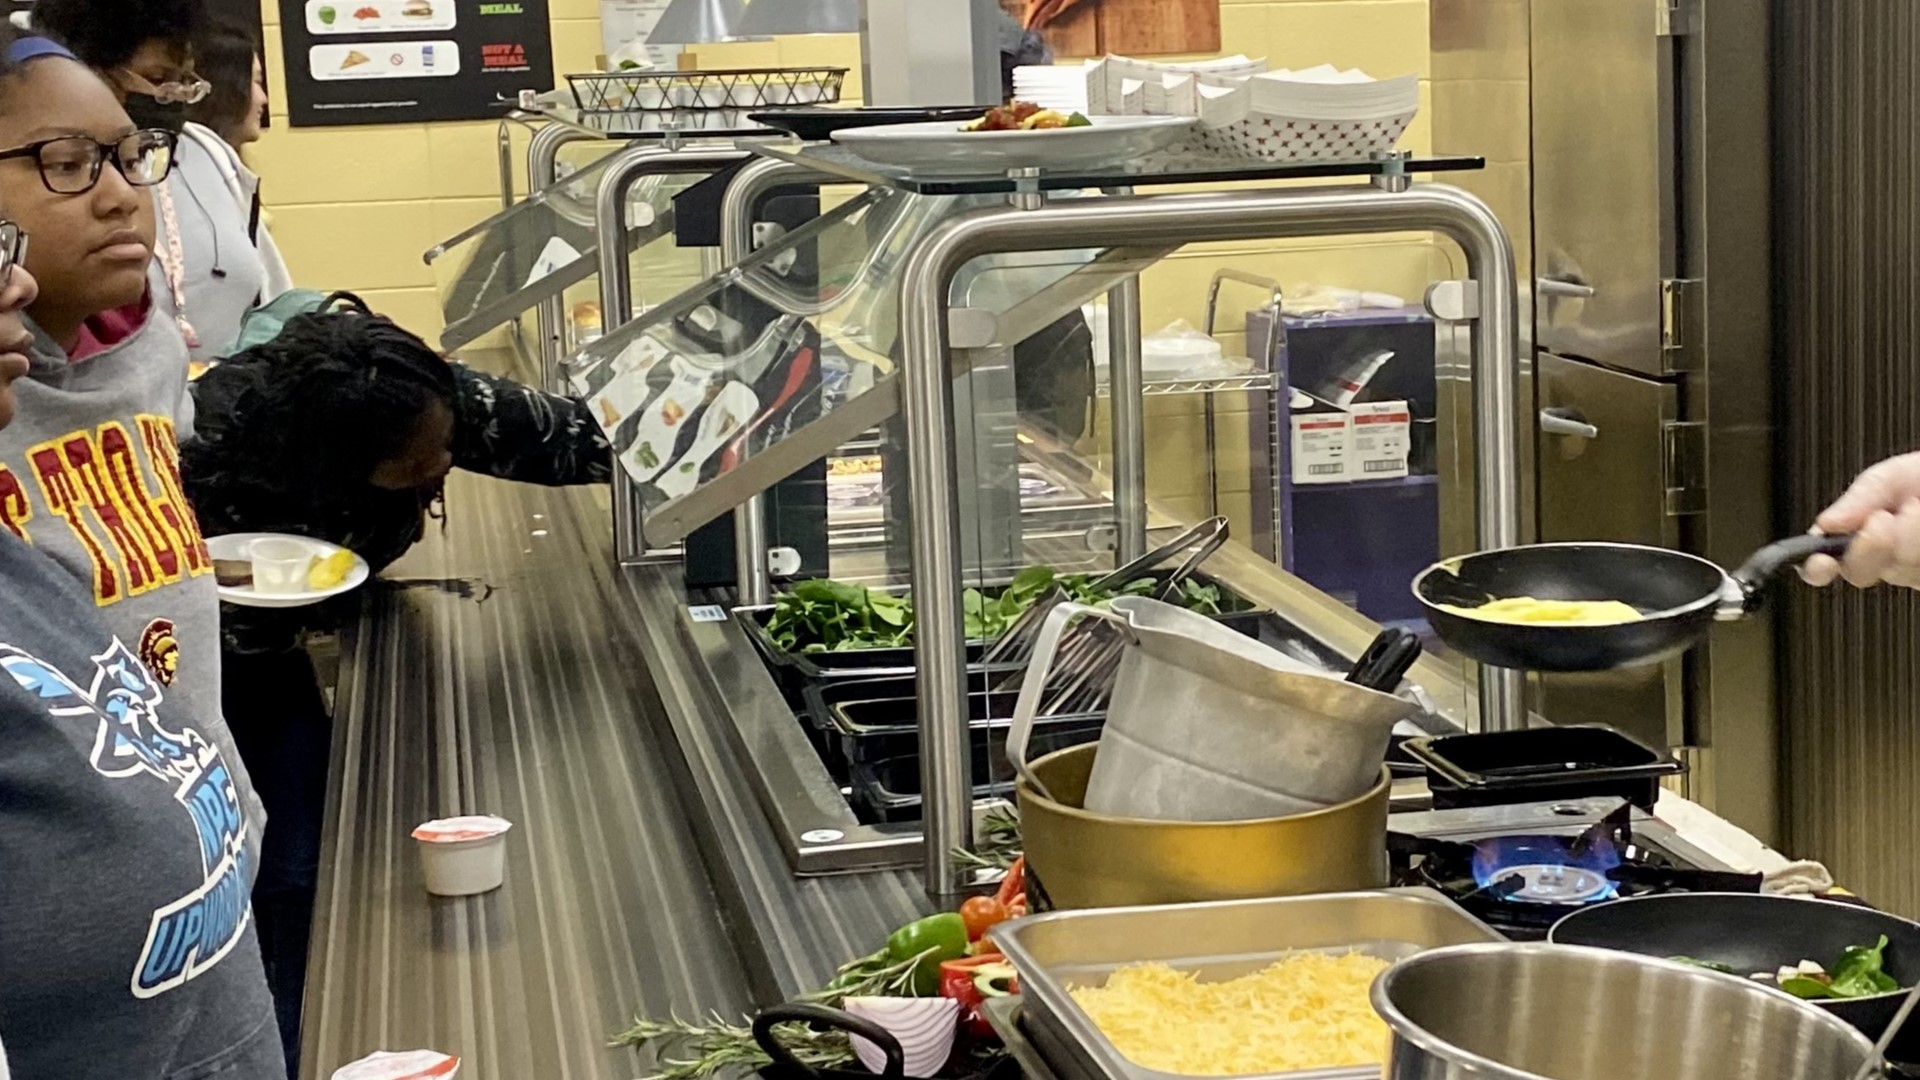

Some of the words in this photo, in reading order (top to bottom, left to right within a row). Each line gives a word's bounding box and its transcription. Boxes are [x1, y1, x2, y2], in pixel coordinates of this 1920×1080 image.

[479, 3, 524, 15] MEAL
[481, 44, 512, 55] NOT
[514, 43, 525, 54] A
[484, 55, 528, 66] MEAL
